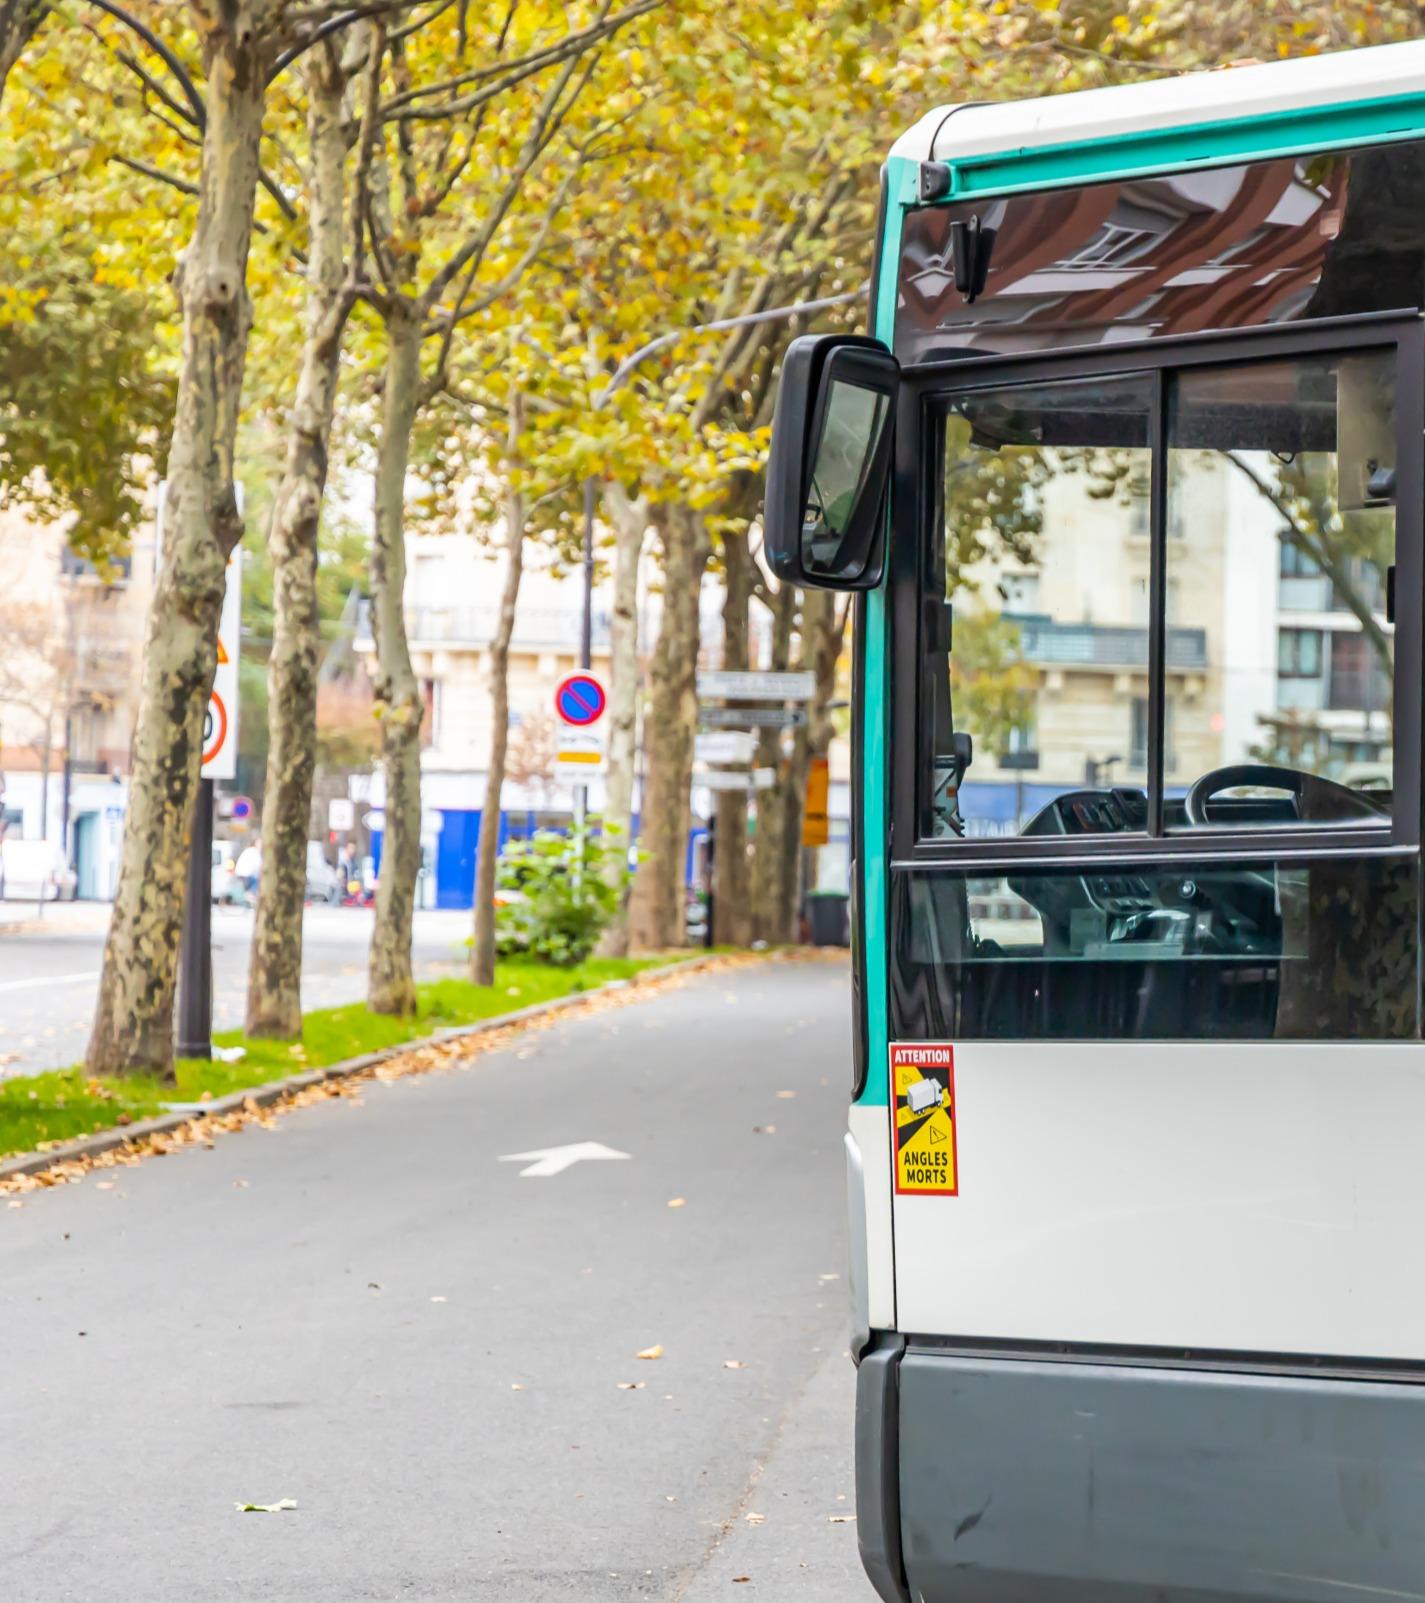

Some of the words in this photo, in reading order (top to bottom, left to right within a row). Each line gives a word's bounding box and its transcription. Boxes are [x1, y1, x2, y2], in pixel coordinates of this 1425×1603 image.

[895, 1049, 950, 1063] ATTENTION
[904, 1151, 948, 1166] ANGLES
[907, 1169, 947, 1184] MORTS
